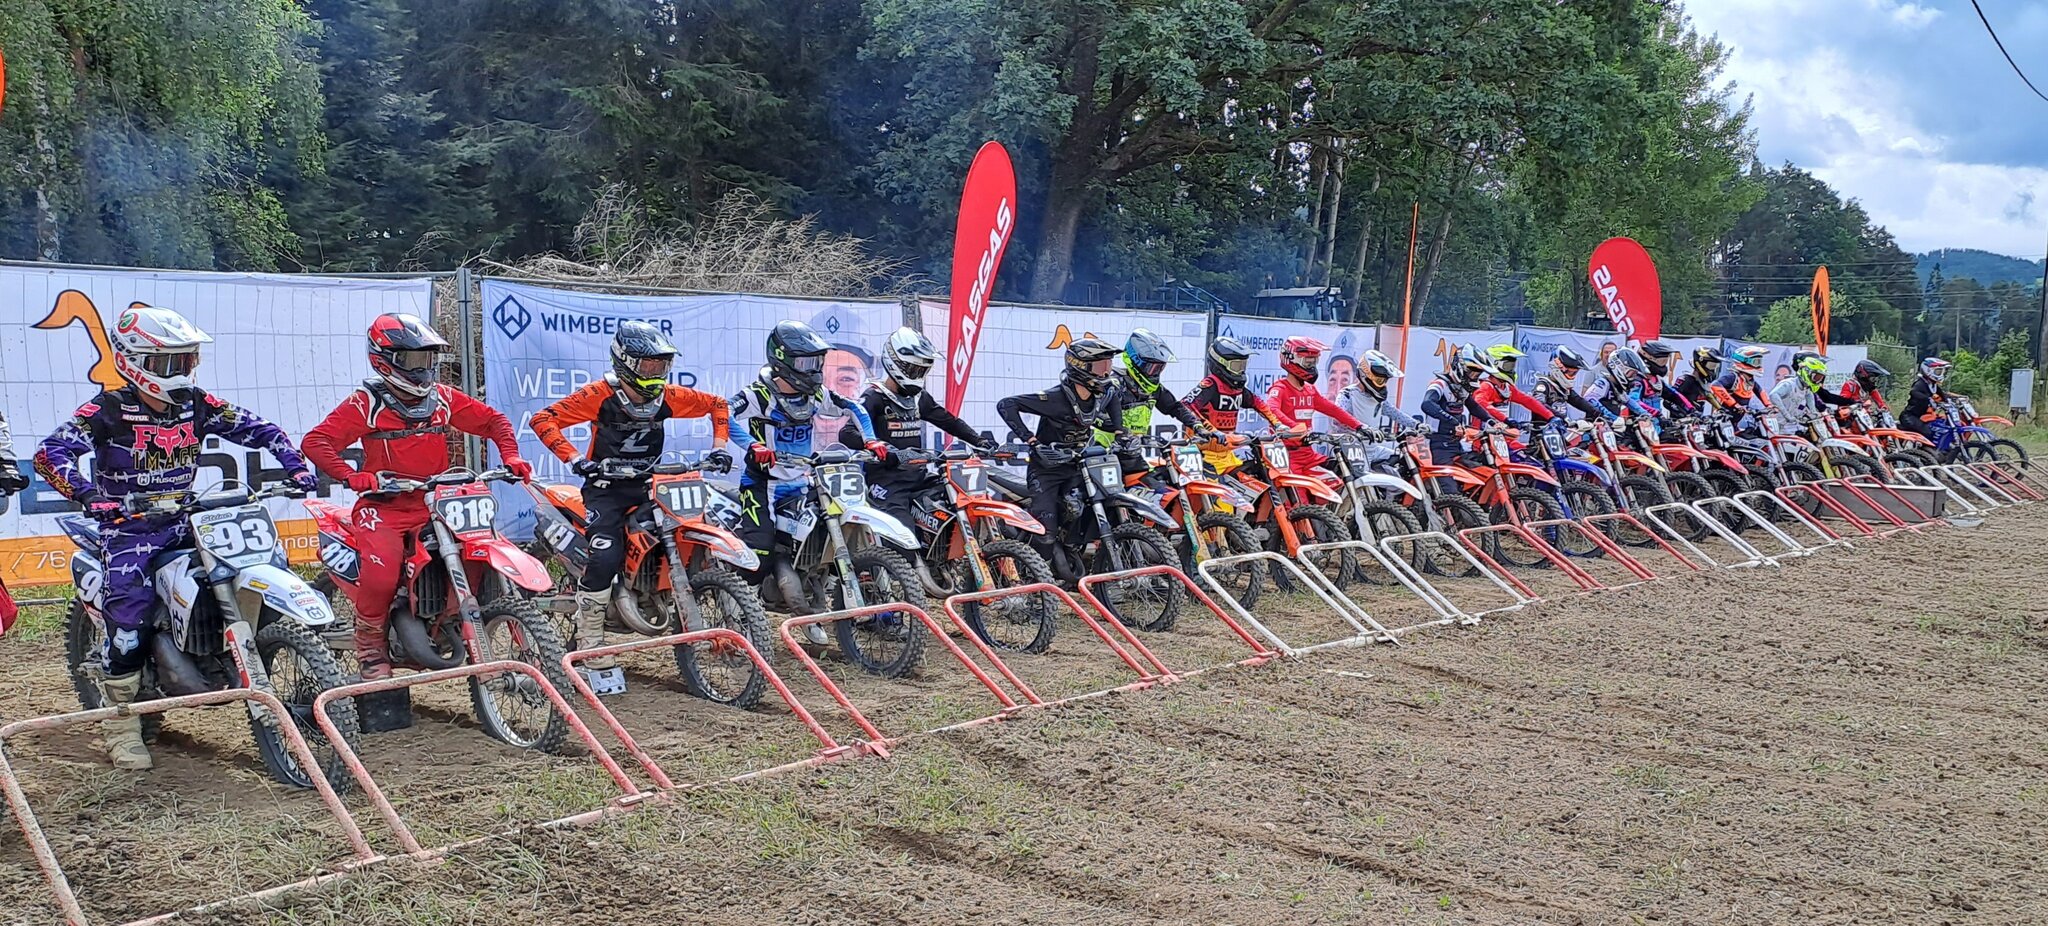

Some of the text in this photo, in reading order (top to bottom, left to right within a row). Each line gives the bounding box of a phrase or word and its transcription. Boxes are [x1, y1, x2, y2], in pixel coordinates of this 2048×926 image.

[952, 197, 1012, 386] GASGAS
[541, 312, 673, 337] WIMBER
[1179, 453, 1203, 474] 241
[1268, 446, 1289, 469] 281
[151, 472, 192, 485] Husqvarn
[828, 473, 864, 497] 13
[961, 467, 981, 491] 7
[1102, 467, 1118, 486] 8
[669, 486, 702, 511] 111
[445, 498, 495, 531] 818
[911, 504, 939, 531] WIMMER
[213, 518, 274, 557] 93
[321, 542, 357, 573] 818
[228, 640, 246, 674] MOTUL
